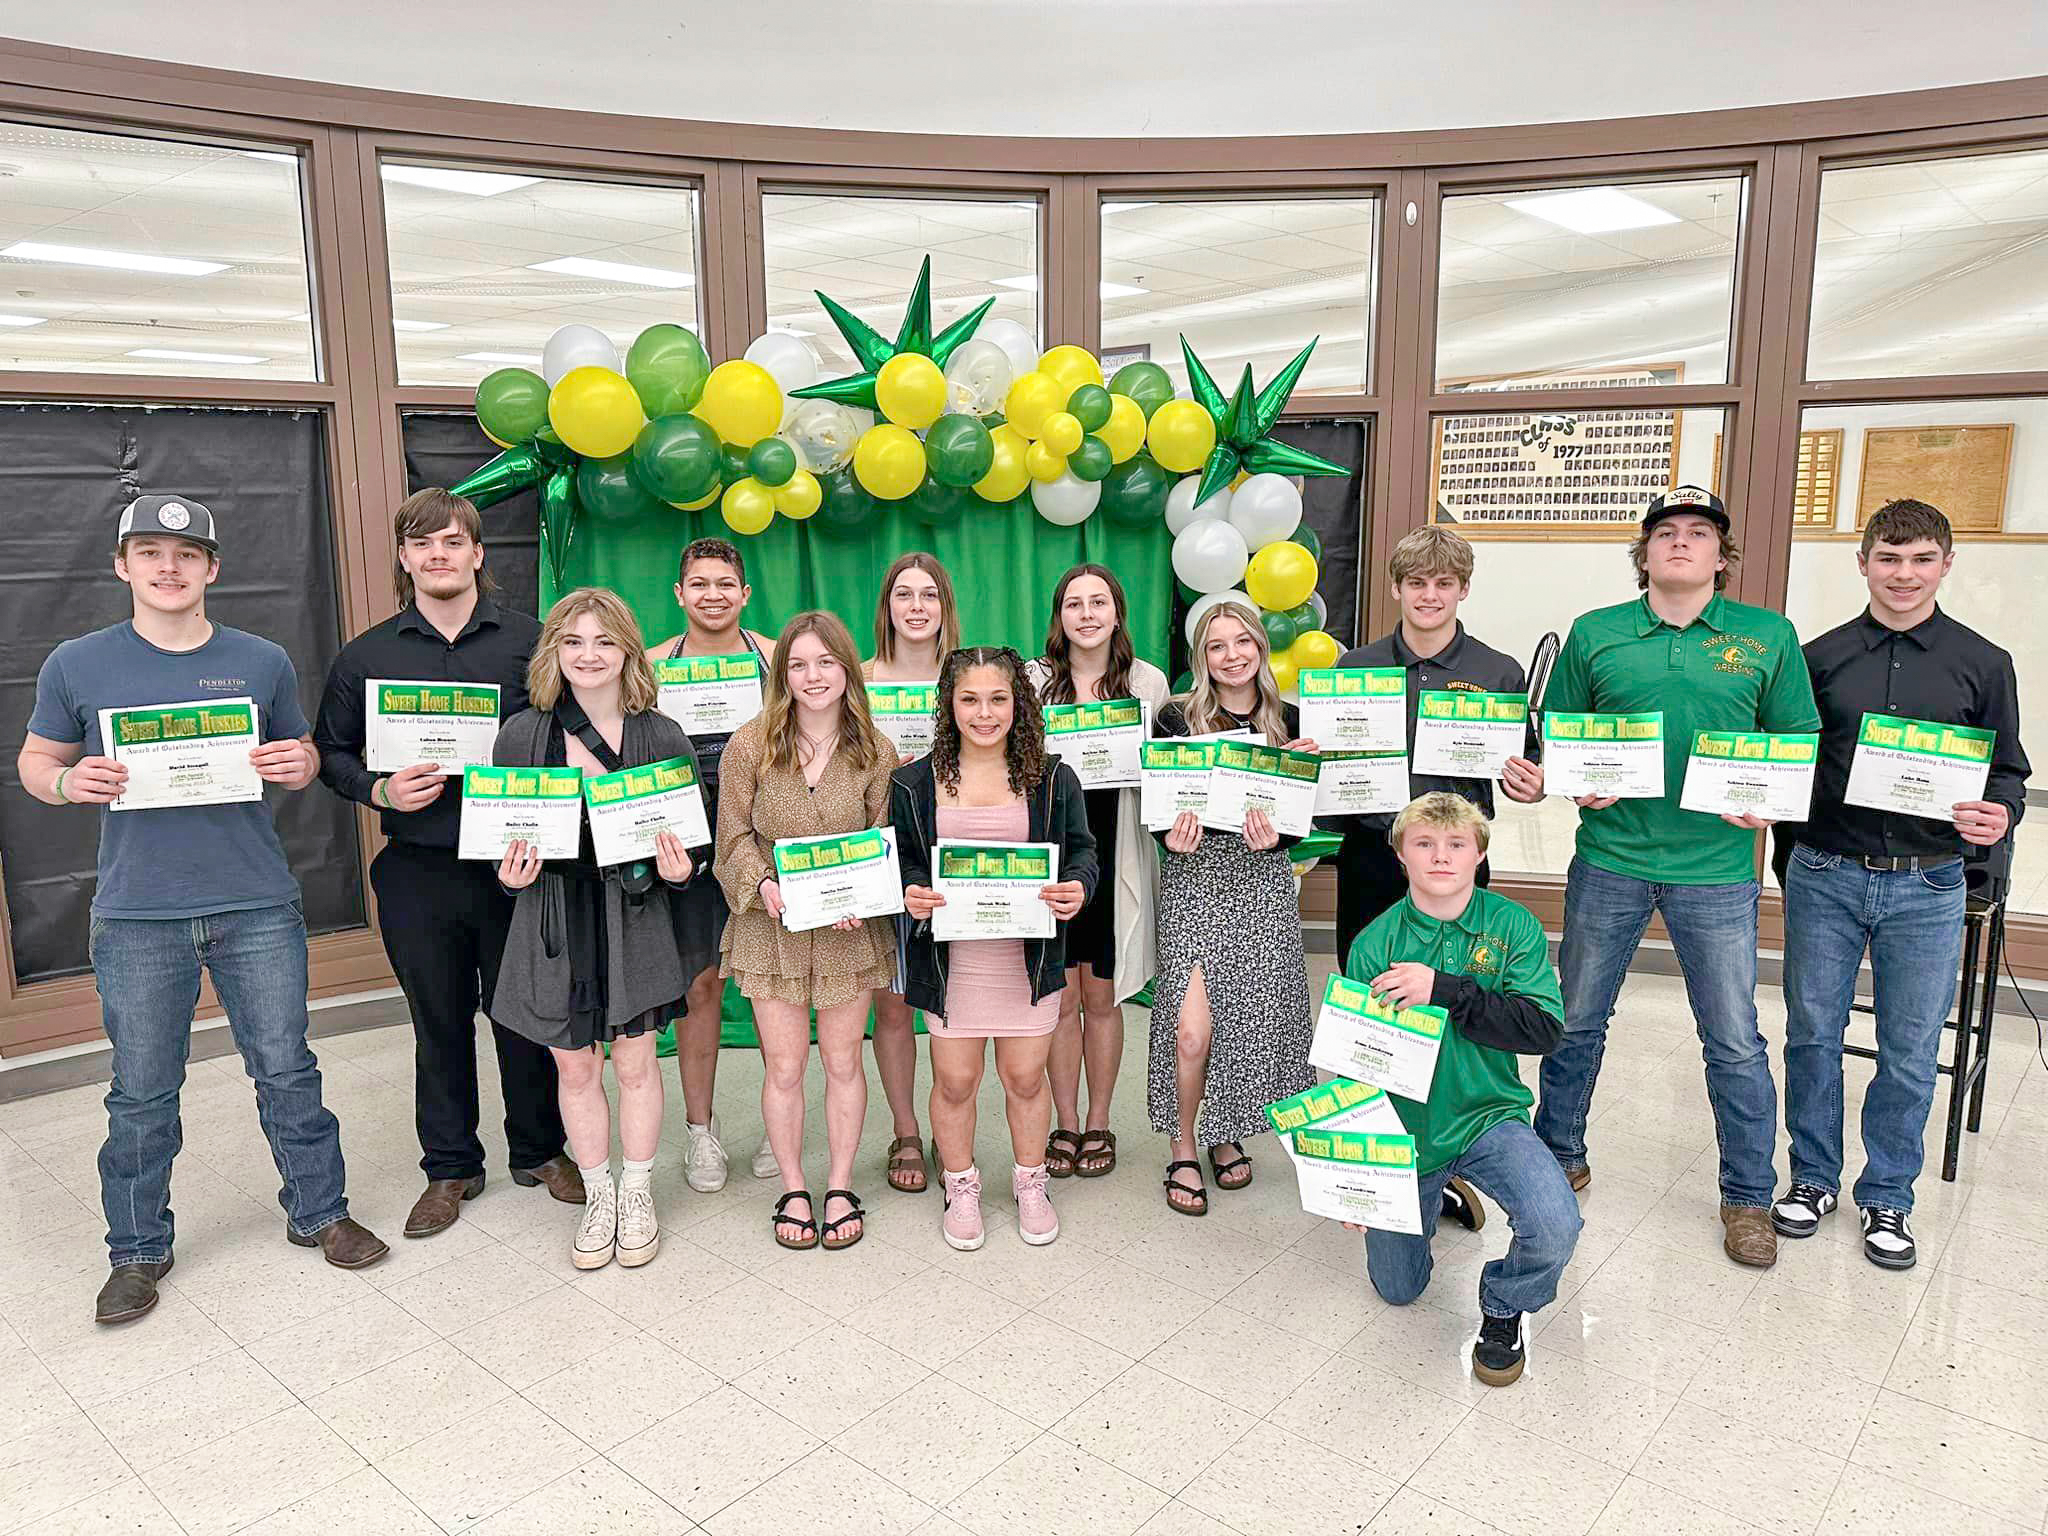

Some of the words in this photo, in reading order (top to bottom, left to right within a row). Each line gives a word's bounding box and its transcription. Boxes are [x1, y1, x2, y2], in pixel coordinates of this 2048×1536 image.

[1538, 437, 1551, 452] of
[1553, 444, 1584, 458] 1977
[1702, 635, 1737, 648] SWEET
[1741, 637, 1766, 656] HOME
[1447, 680, 1468, 689] SWEET
[384, 689, 417, 711] SWEET
[420, 690, 450, 712] HOME
[452, 691, 495, 714] HUSKIES
[119, 717, 160, 741] SWEET
[161, 714, 197, 738] HOME
[199, 710, 248, 734] HUSKIES
